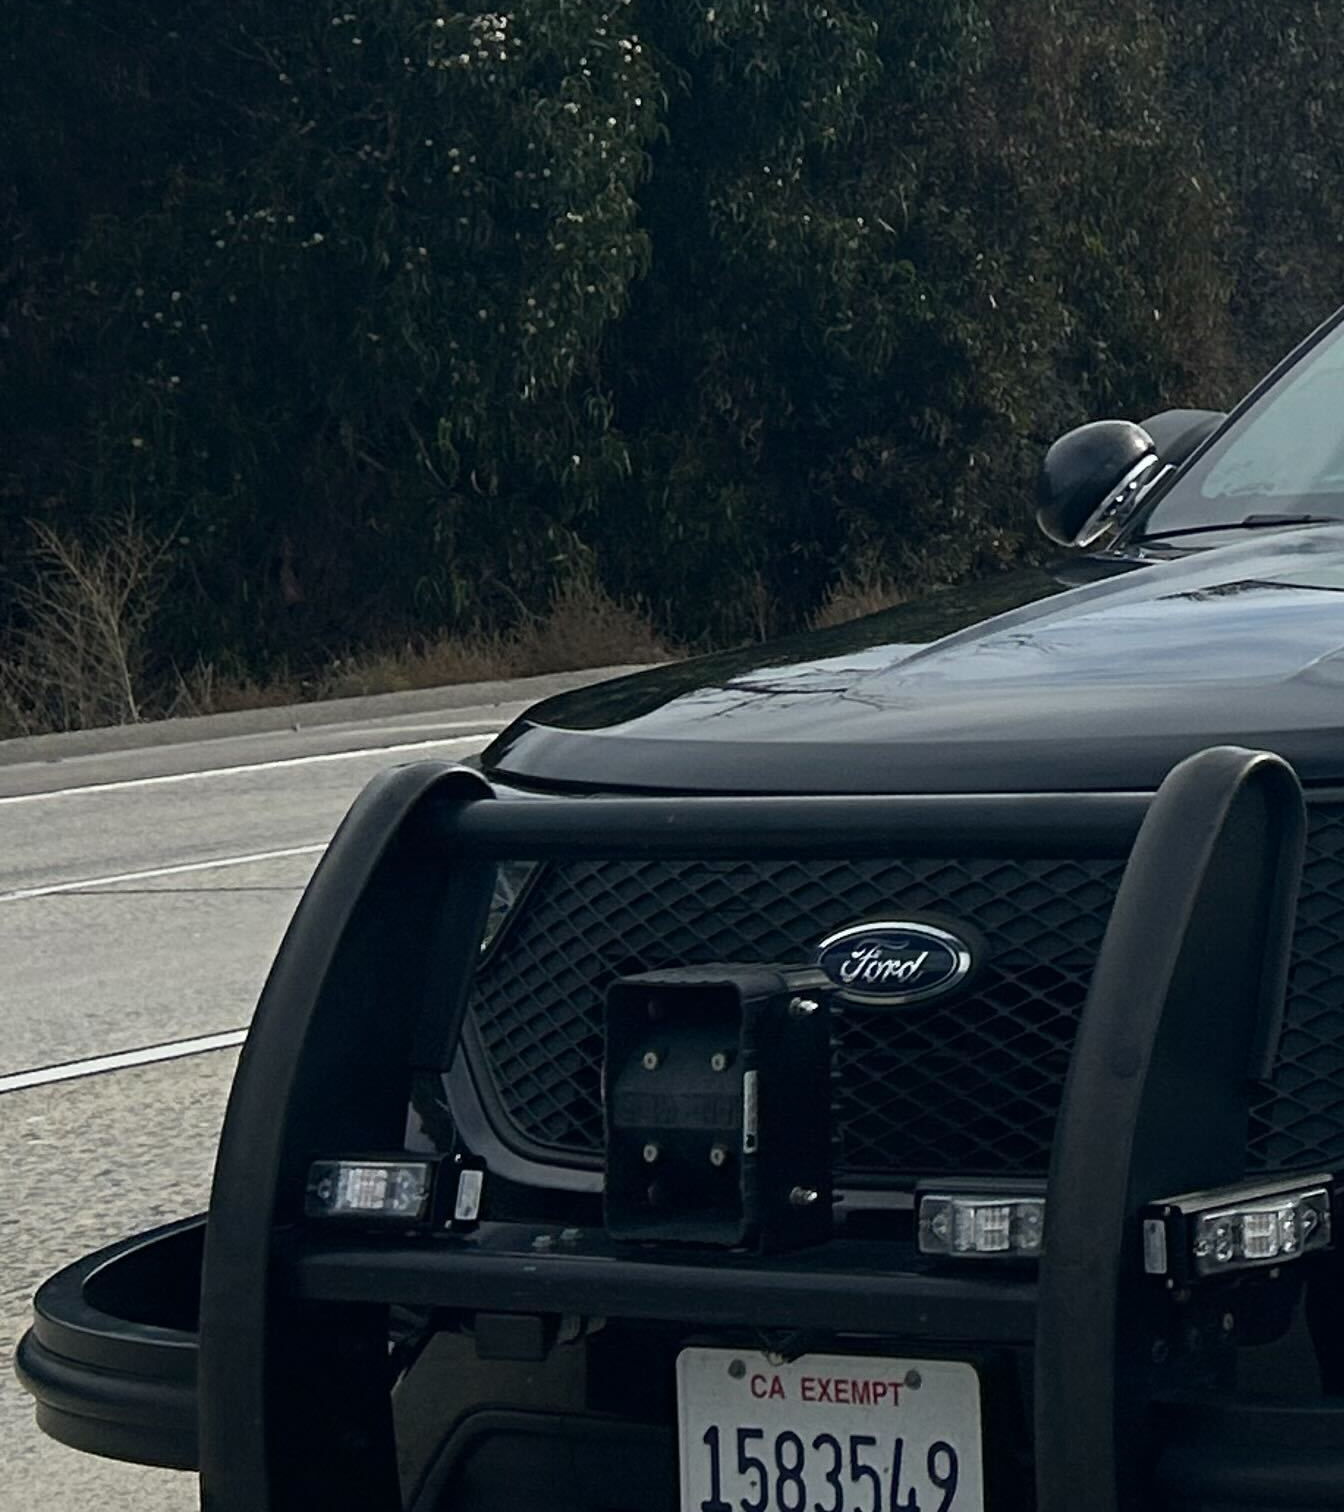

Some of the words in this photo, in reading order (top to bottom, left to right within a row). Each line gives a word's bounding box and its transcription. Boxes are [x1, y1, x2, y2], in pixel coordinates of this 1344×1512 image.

[839, 939, 930, 984] Ford
[750, 1373, 786, 1400] CA
[800, 1376, 905, 1407] EXEMPT
[700, 1424, 960, 1512] 1583549
